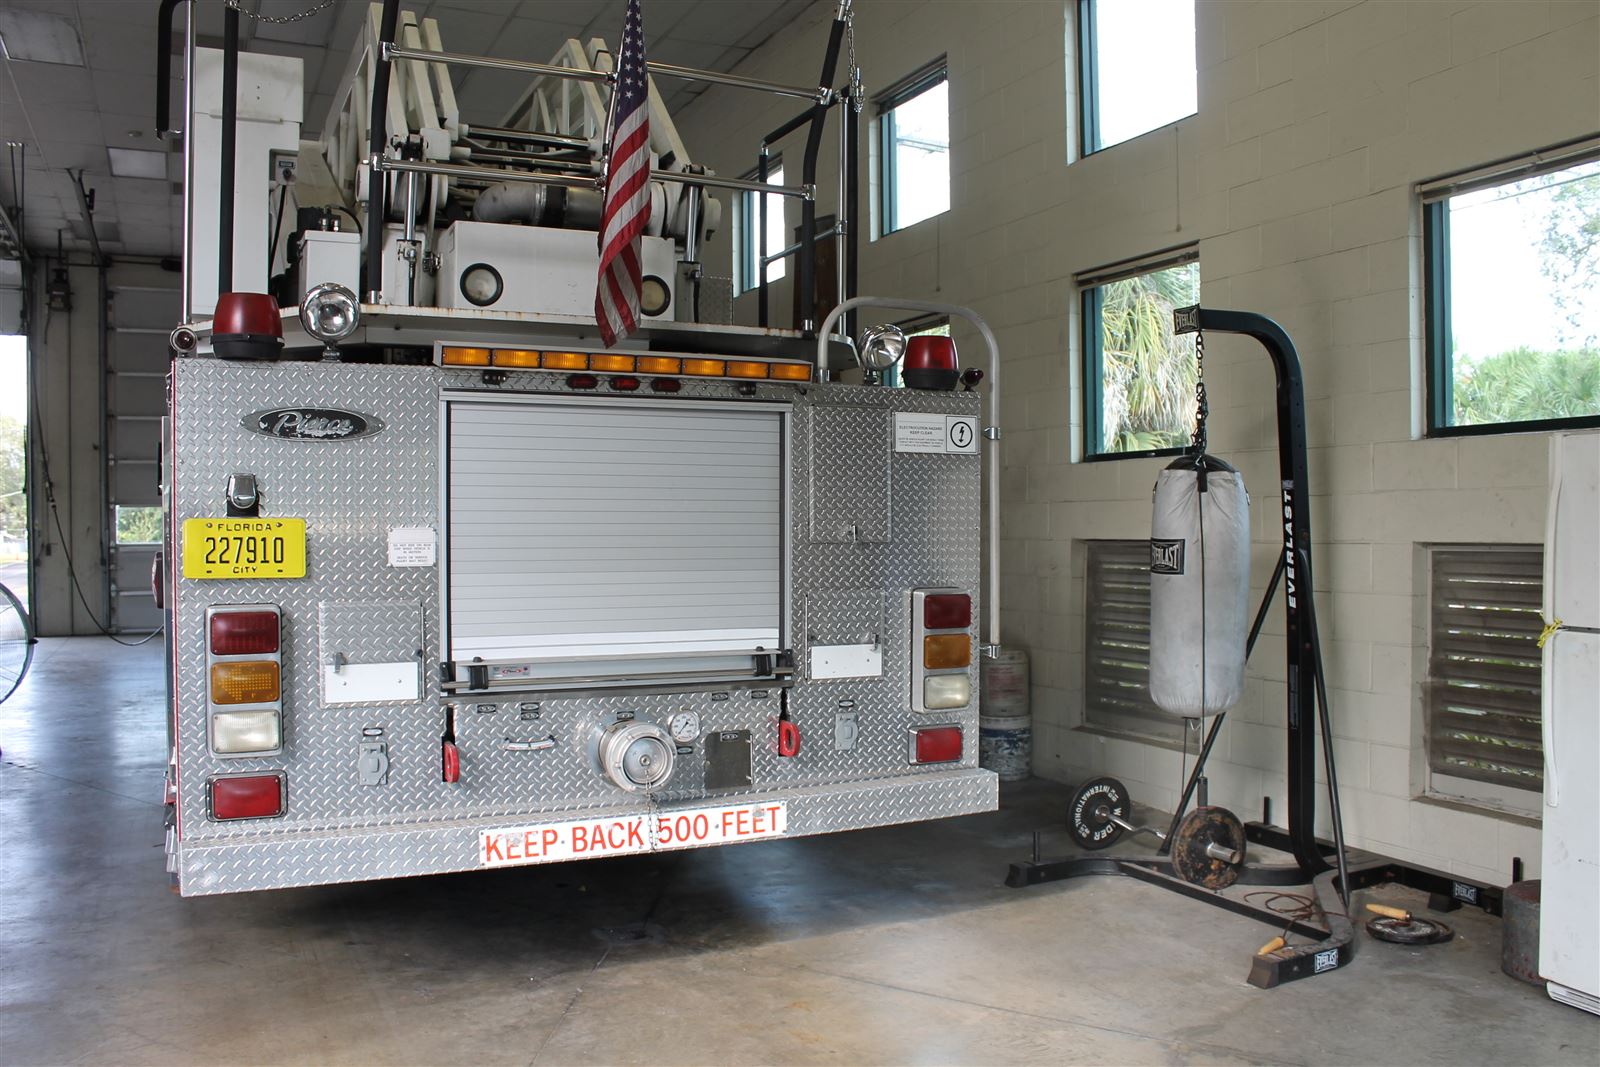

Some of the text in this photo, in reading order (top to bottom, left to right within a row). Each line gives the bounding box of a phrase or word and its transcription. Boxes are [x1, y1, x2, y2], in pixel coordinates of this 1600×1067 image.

[273, 411, 354, 437] Pierce
[217, 523, 272, 531] FLORIDA
[205, 536, 285, 565] 227910
[1284, 491, 1297, 609] EVERLAST
[232, 566, 257, 574] CITY
[485, 806, 781, 862] KEEP BACK 500 FEET
[1093, 807, 1122, 841] WIDER
